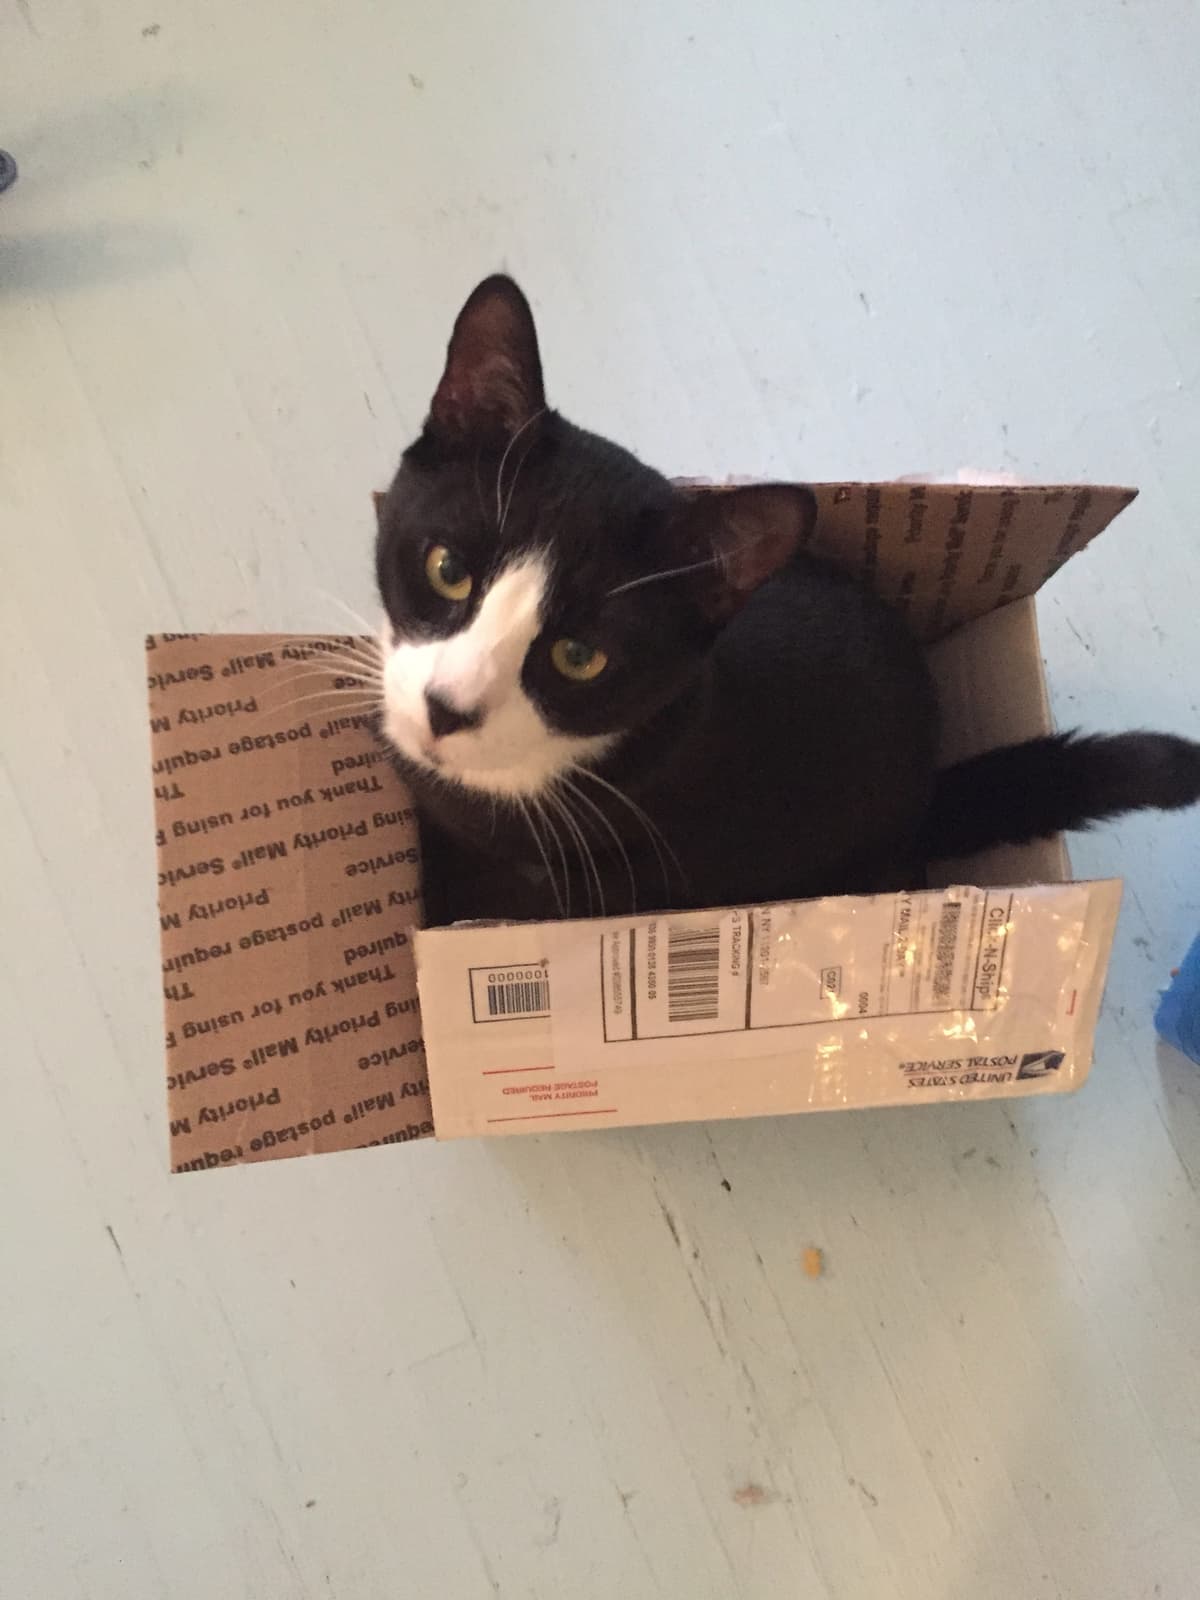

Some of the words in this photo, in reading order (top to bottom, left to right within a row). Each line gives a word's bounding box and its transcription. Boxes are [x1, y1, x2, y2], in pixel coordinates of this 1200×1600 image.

[148, 664, 214, 690] Servic
[178, 696, 259, 725] Priority
[228, 721, 312, 756] postage
[276, 789, 315, 812] you
[319, 776, 383, 802] Thank
[172, 812, 235, 838] using
[240, 802, 271, 821] for
[293, 820, 369, 850] Priority
[158, 857, 226, 887] Servic
[345, 847, 418, 877] Service
[188, 888, 270, 921] Priority
[239, 912, 324, 950] postage
[343, 931, 409, 966] quired
[731, 925, 742, 970] TRACKING
[288, 980, 328, 1006] you
[331, 964, 396, 993] Thank
[250, 998, 283, 1019] for
[182, 1010, 245, 1039] using
[305, 1010, 381, 1046] Priority
[358, 1038, 425, 1071] ervice
[966, 1054, 1019, 1069] POSTAL
[167, 1058, 238, 1090] Servic
[553, 1079, 599, 1091] POSTAGE
[906, 1076, 958, 1089] STATES
[959, 1072, 1013, 1086] UNITED
[501, 1083, 552, 1096] REQUIRED
[528, 1093, 553, 1103] MAIL
[553, 1088, 599, 1100] PRIORITY
[198, 1087, 281, 1125] Priority
[250, 1108, 336, 1153] postage
